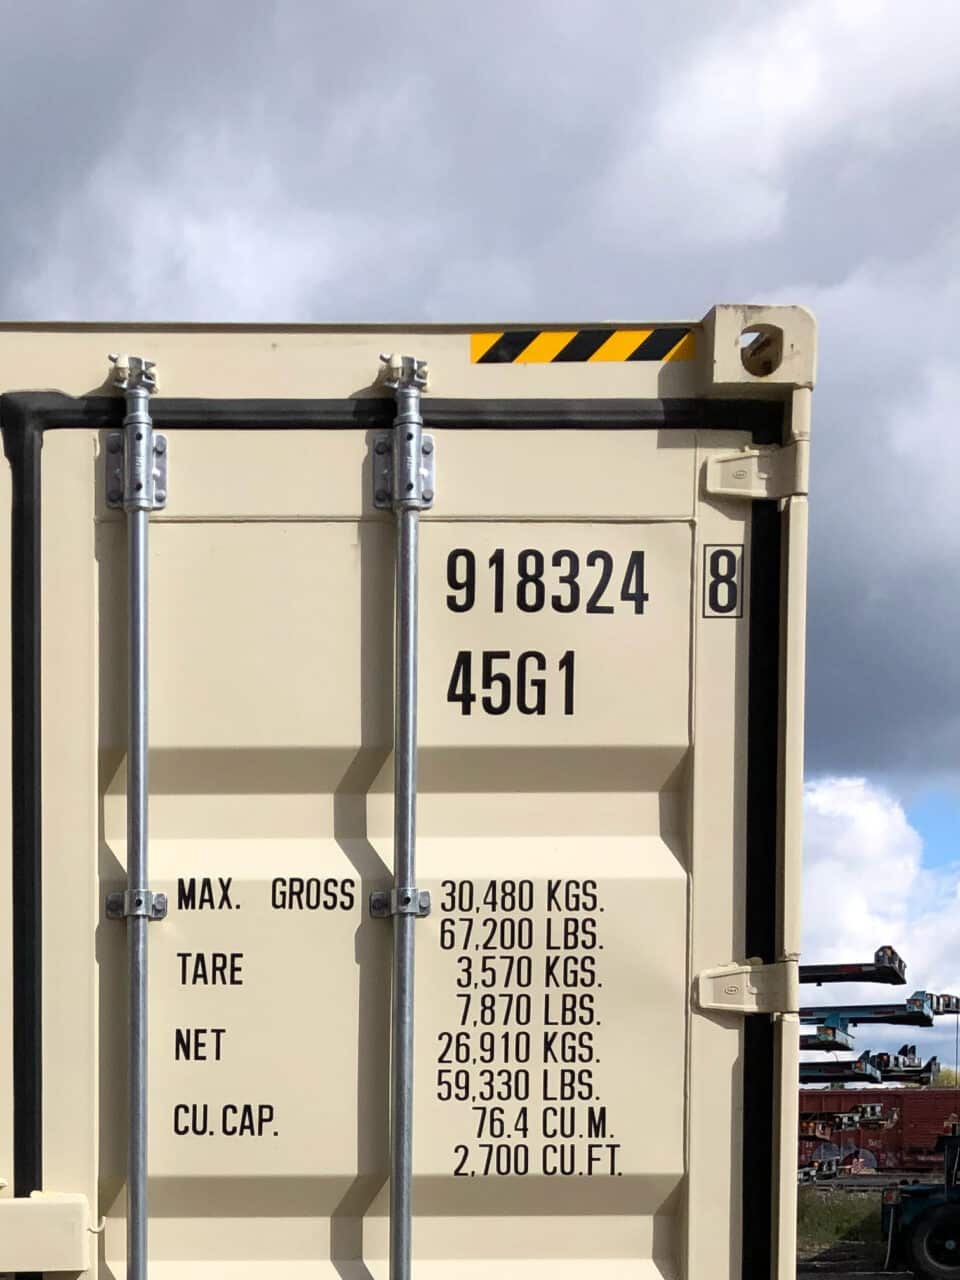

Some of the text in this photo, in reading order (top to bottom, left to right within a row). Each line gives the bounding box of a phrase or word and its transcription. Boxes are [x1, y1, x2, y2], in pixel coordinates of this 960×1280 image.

[446, 548, 738, 615] 918324 8
[446, 650, 575, 716] 45G1
[177, 877, 604, 914] MAX. GROSS 30,480 KGS.
[440, 917, 603, 951] 67,200 LBS.
[176, 952, 602, 990] TARE 3,570 KGS.
[456, 993, 601, 1027] 7,870 LBS.
[175, 1028, 601, 1065] NET 26,910 KGS.
[437, 1068, 600, 1103] 59,330 LBS.
[471, 1106, 529, 1139] 76.4
[453, 1143, 529, 1178] 2,700
